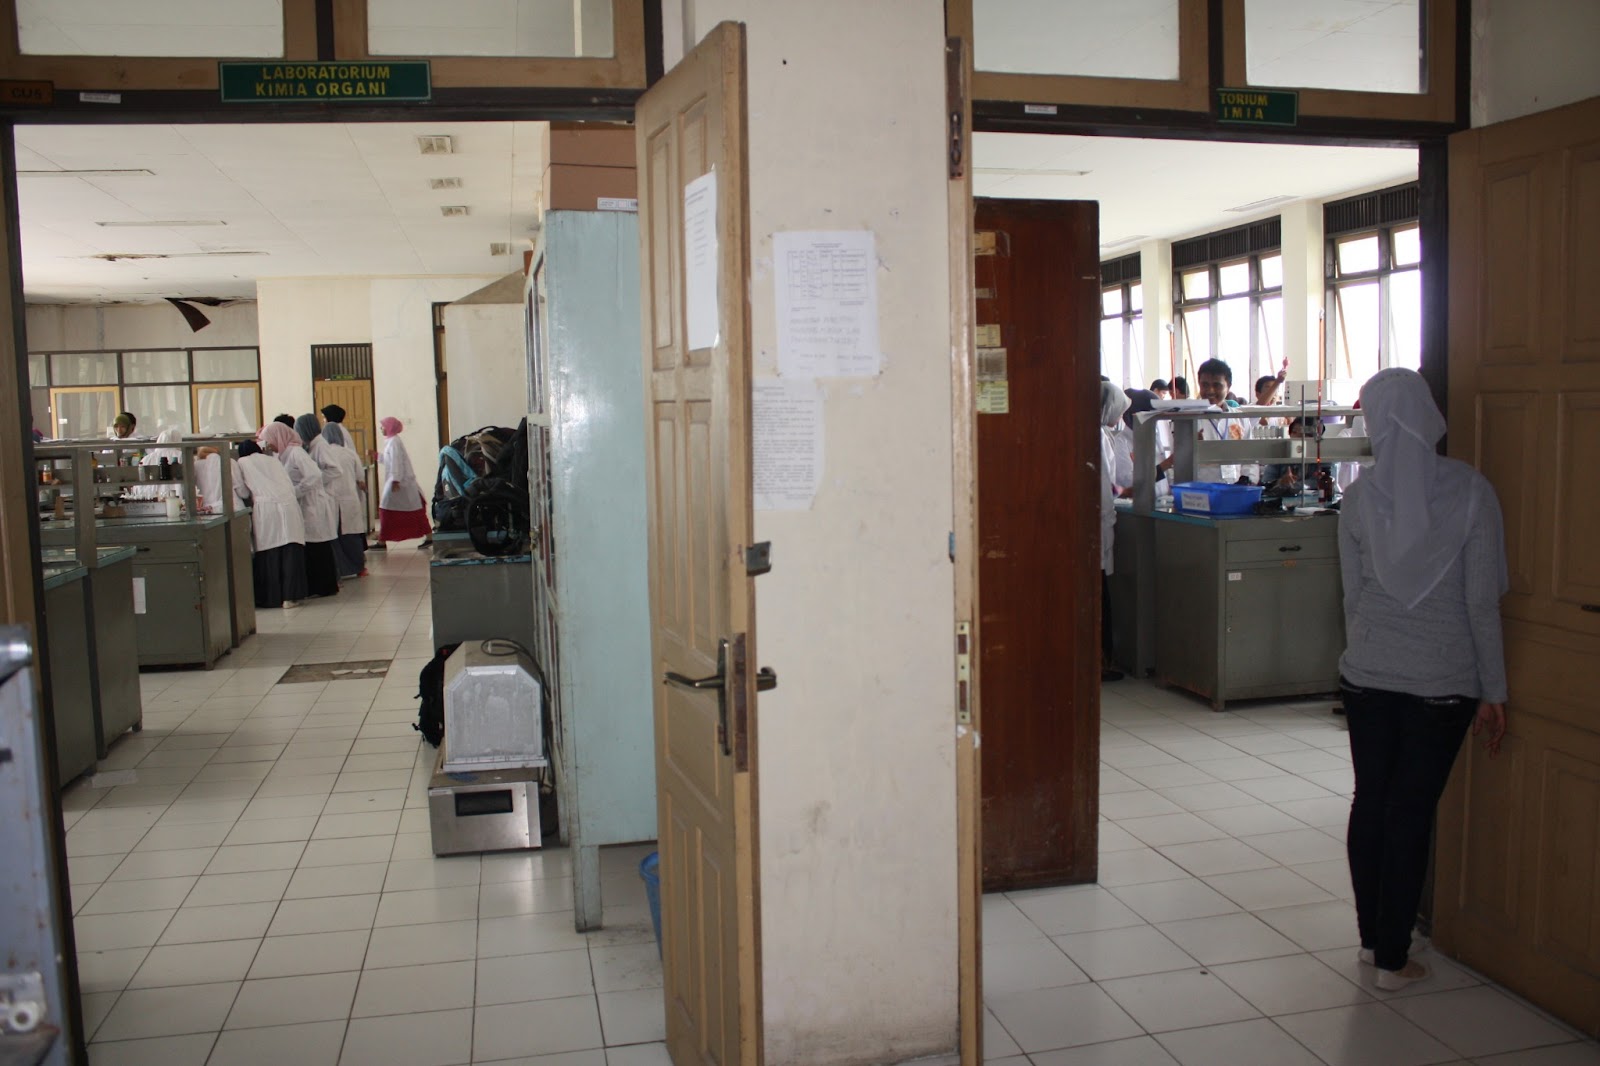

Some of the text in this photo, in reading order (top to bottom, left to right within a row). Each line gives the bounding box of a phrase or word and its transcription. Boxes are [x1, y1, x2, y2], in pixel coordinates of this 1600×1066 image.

[262, 66, 391, 80] LABORATORIUM
[255, 81, 386, 97] KIMIA ORGANI
[1220, 93, 1268, 105] TORIUM
